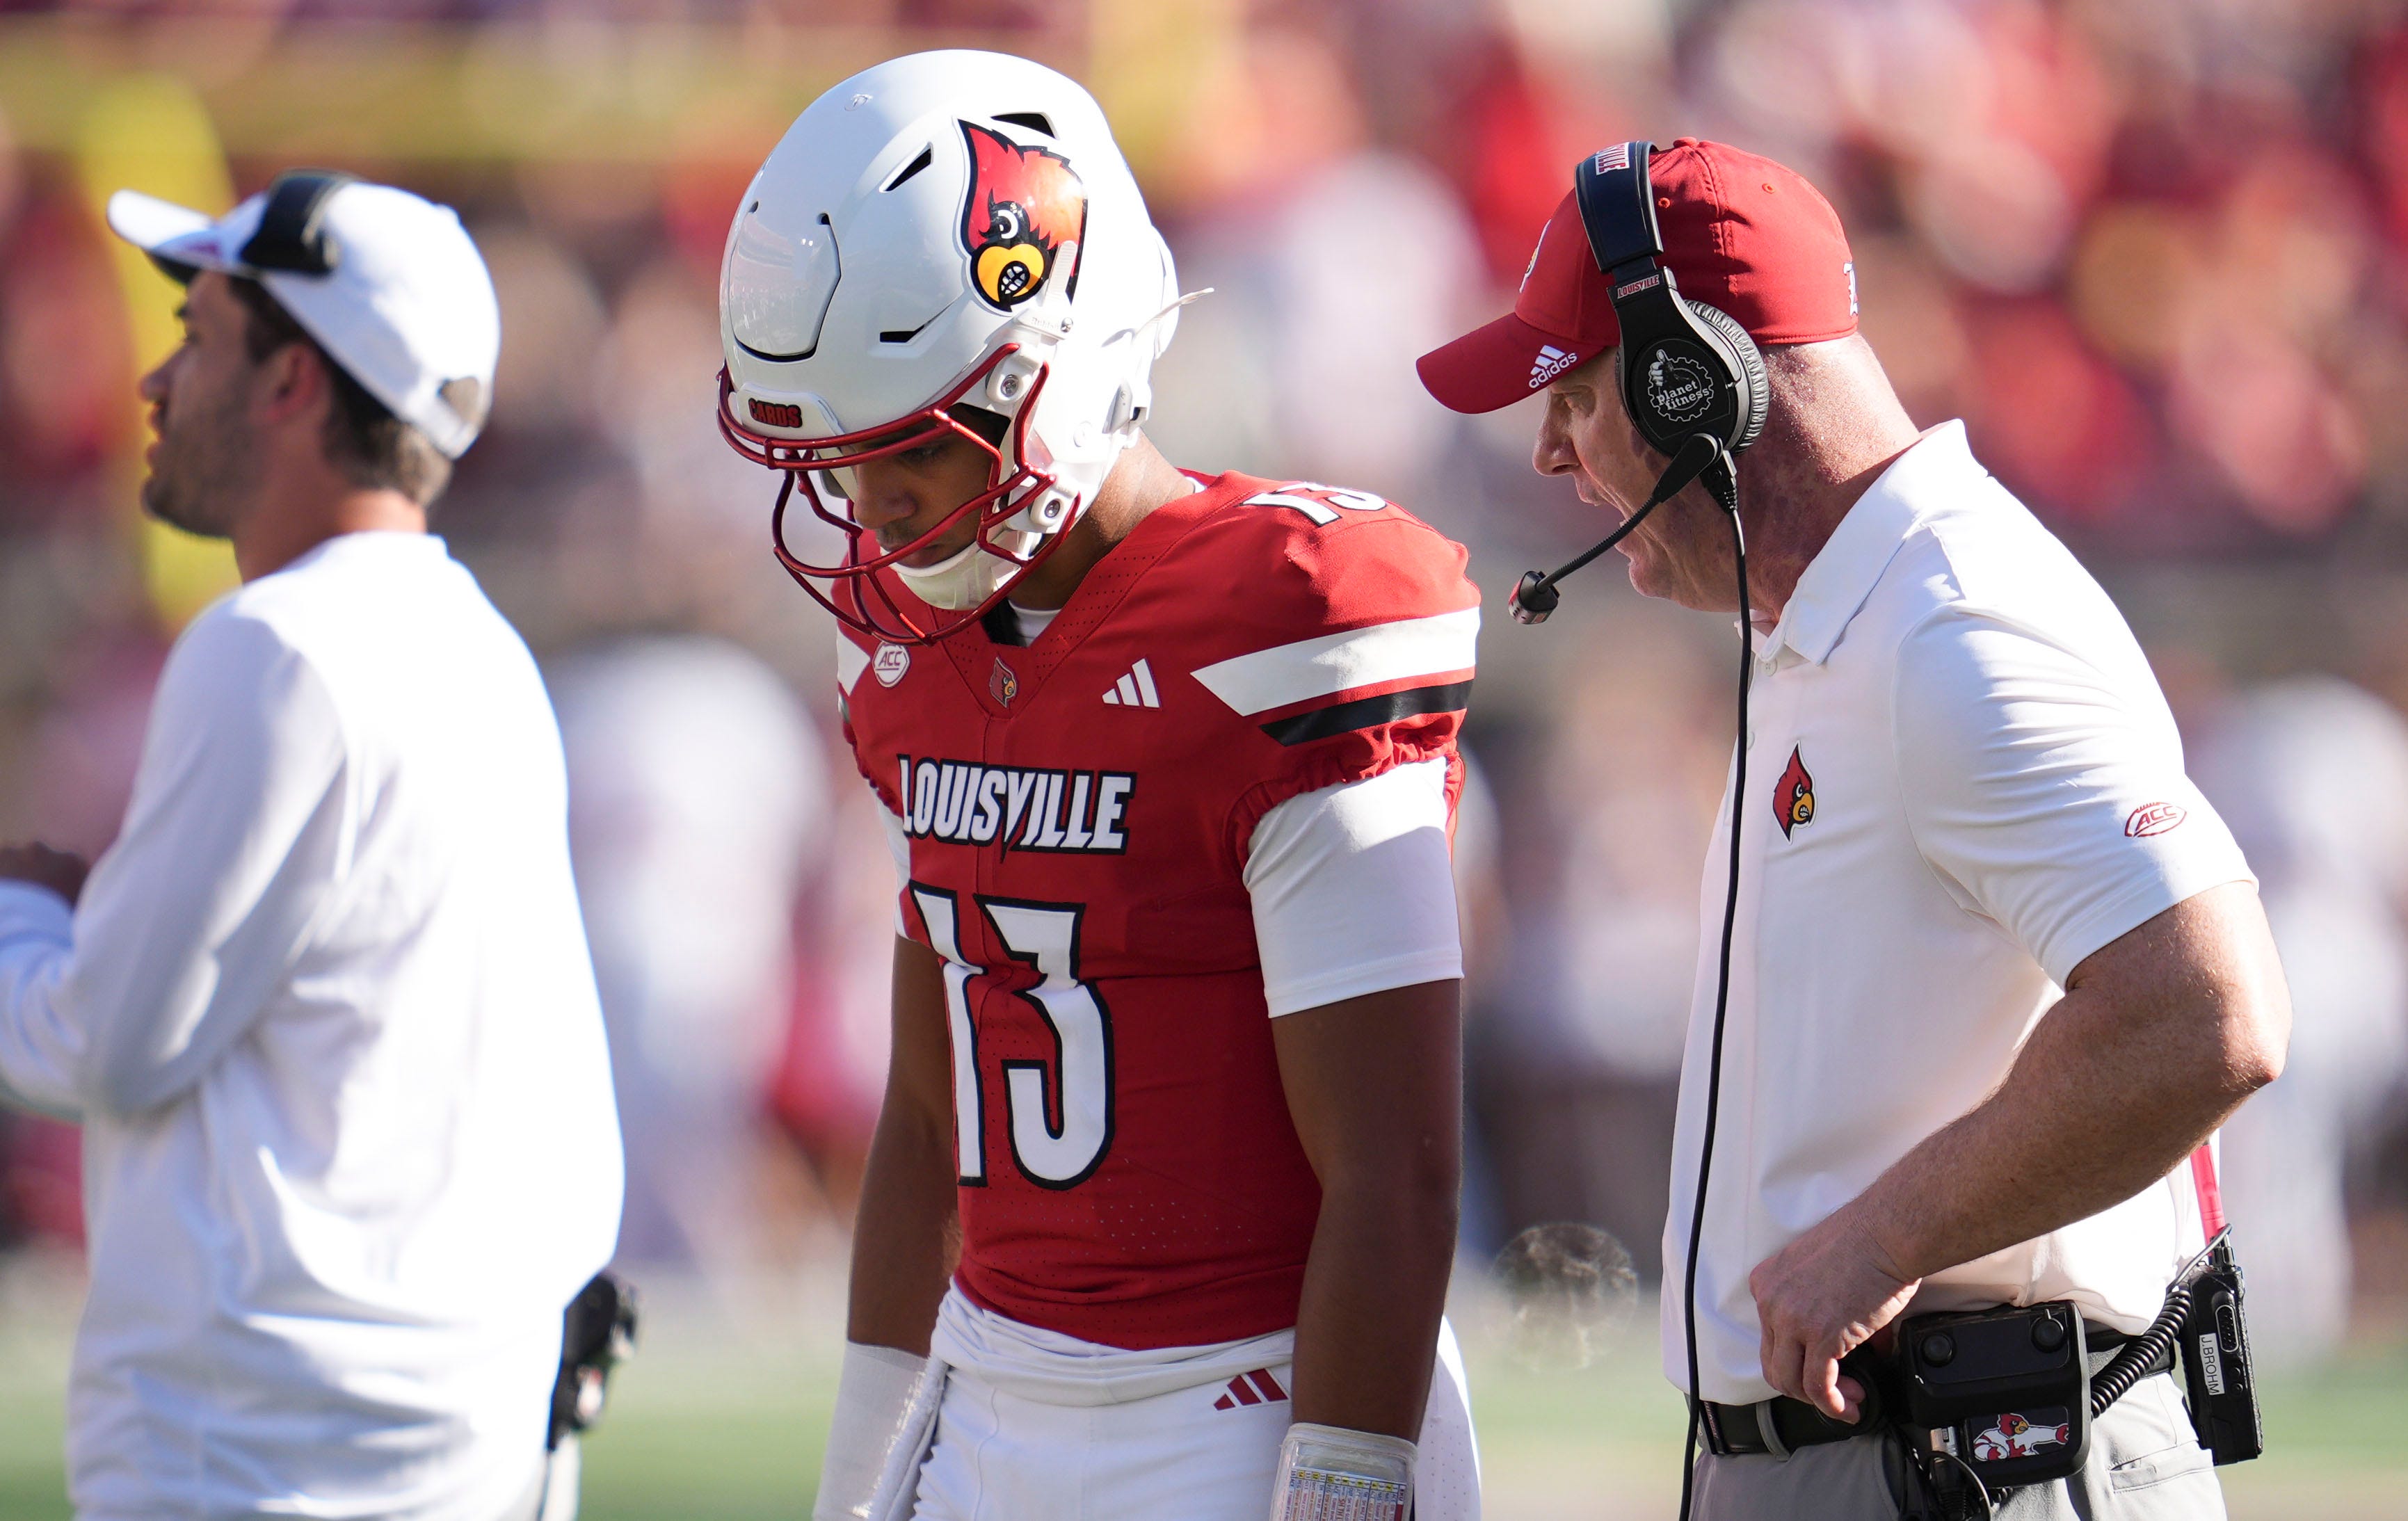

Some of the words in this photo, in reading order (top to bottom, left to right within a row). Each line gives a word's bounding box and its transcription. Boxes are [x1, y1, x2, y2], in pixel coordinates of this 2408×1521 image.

[1617, 274, 1660, 299] LOUISVILLE
[1529, 353, 1578, 389] adidas
[1656, 380, 1698, 405] planet
[1666, 388, 1710, 410] fitness
[748, 397, 803, 428] CARDS
[1235, 481, 1388, 528] 13
[878, 650, 904, 667] ACC
[897, 753, 1137, 862] LOUISVILLE
[2135, 805, 2176, 832] ACC
[908, 879, 1116, 1191] 13
[2201, 1337, 2221, 1394] J.BROHM
